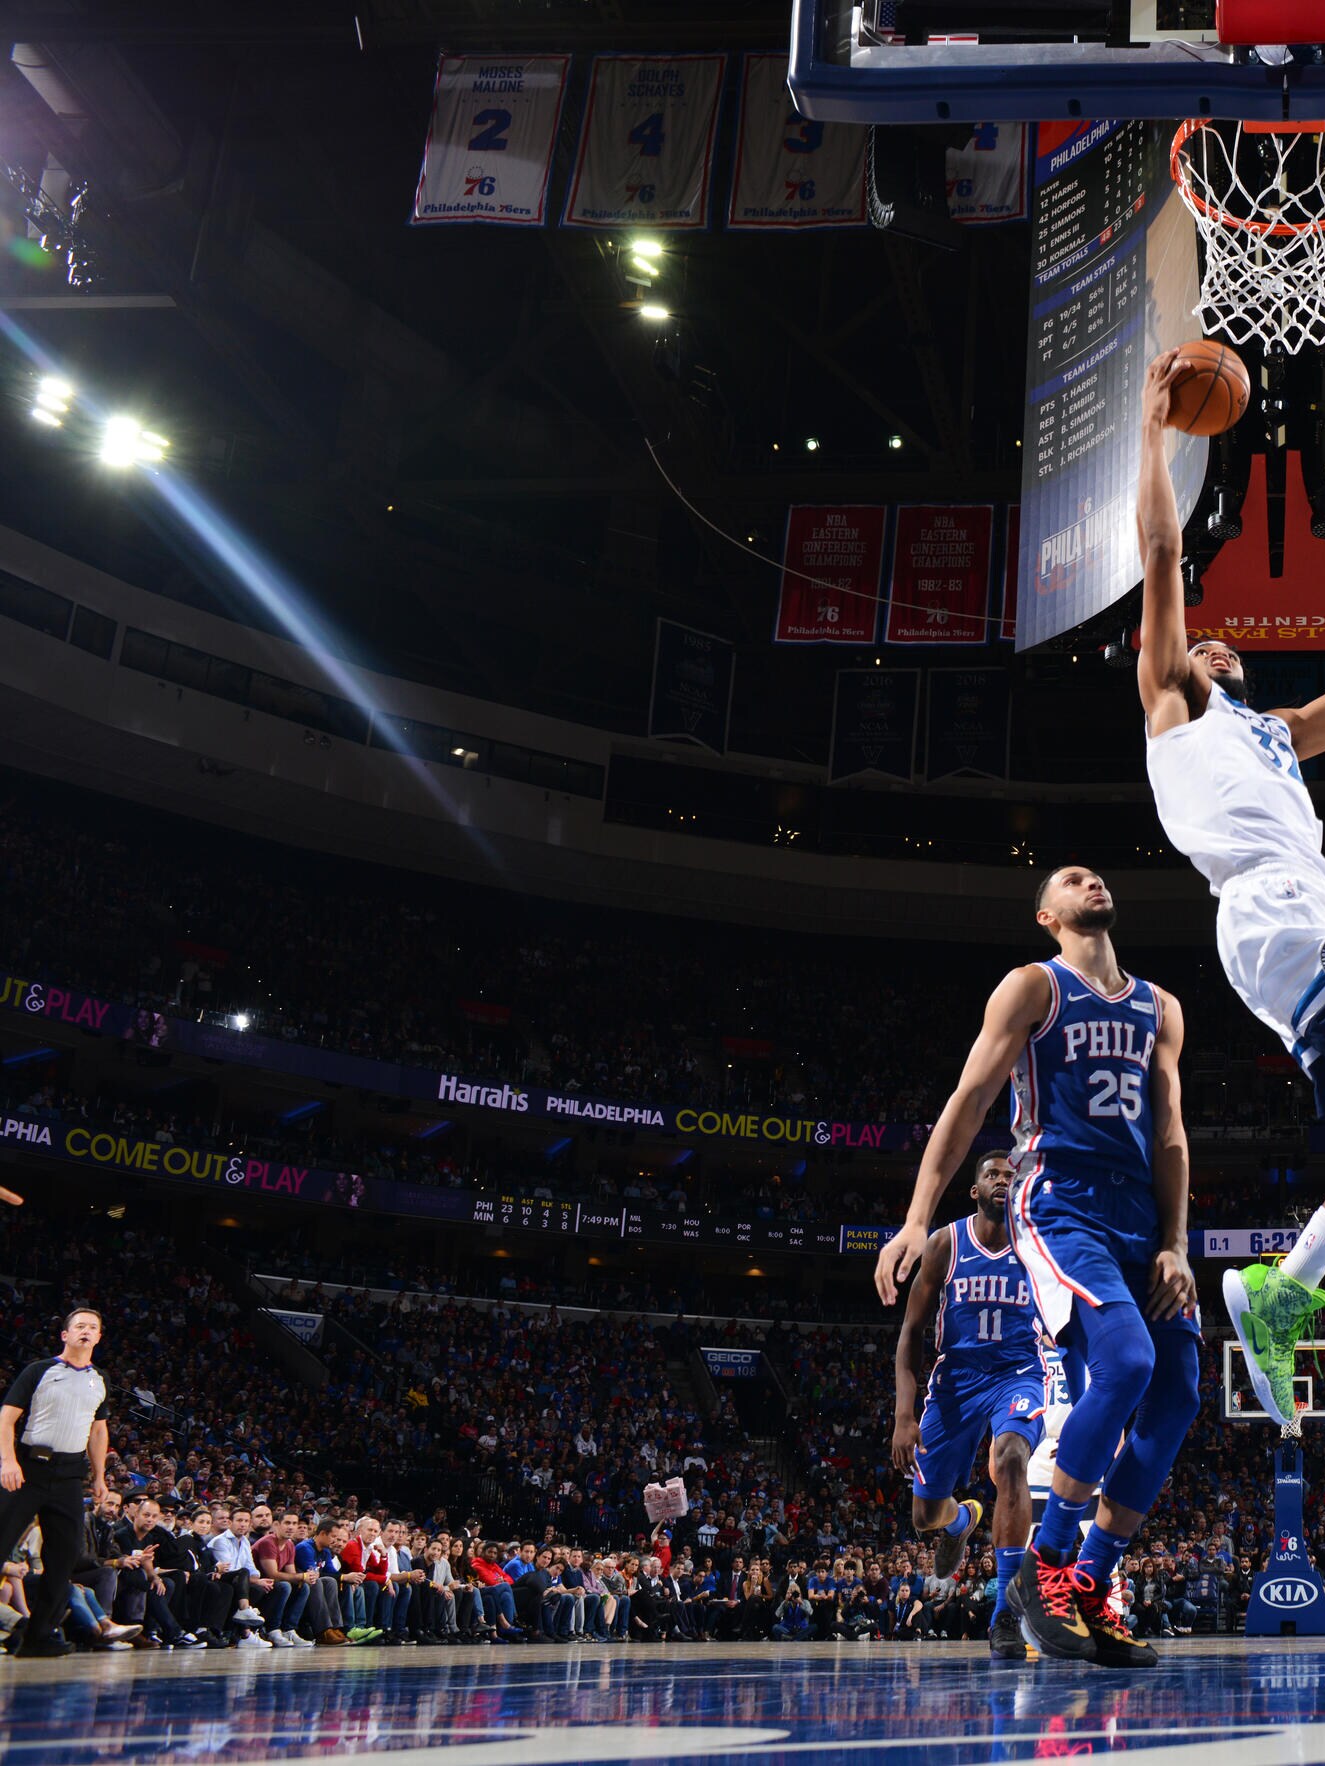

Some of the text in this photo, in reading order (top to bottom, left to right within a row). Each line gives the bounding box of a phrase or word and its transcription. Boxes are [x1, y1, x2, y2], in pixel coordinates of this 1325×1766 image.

[478, 66, 523, 79] MOSES
[637, 69, 680, 82] DOLPH
[472, 81, 524, 94] MALONE
[627, 84, 685, 97] SCHAYES
[467, 109, 512, 151] 2
[627, 113, 665, 157] 4
[784, 111, 824, 153] 3
[1050, 119, 1110, 172] PHILADELPHIA
[464, 176, 496, 196] 76
[625, 184, 656, 204] 76
[784, 179, 815, 200] 76
[1051, 179, 1079, 203] HARRIS
[423, 203, 531, 215] Philadelphia 76ers
[743, 206, 818, 218] Philadelphia
[1051, 189, 1086, 217] HORFORD
[582, 208, 655, 220] Philadelphia
[1050, 205, 1086, 233] SIMMONS
[1050, 229, 1072, 248] ENNIS
[1050, 234, 1086, 263] KORKMAZ
[1038, 248, 1089, 284] TEAM TOTALS
[1071, 256, 1116, 295] TEAM STATS
[1062, 338, 1118, 384] TEAM LEADERS
[1040, 374, 1098, 415] PTS HARRIS
[1039, 391, 1095, 431] REB EMBIID
[1038, 399, 1106, 446] AST SIMMONS
[1038, 423, 1095, 462] BLK EMBIID
[1038, 424, 1115, 478] STL RICHARDSON
[826, 514, 848, 527] NBA
[811, 528, 859, 540] EASTERN
[920, 529, 968, 541] EASTERN
[802, 541, 867, 553] CONFERENCE
[910, 543, 975, 555] CONFERENCE
[1041, 525, 1082, 576] PHILA
[804, 555, 863, 567] CHAMPIONS
[912, 556, 972, 568] CHAMPIONS
[918, 579, 962, 592] 1982-83
[816, 606, 840, 623] 76
[1224, 616, 1325, 627] CENTER
[1186, 627, 1269, 639] FARG
[1064, 1020, 1156, 1068] PHILA
[1088, 1069, 1142, 1121] 25
[546, 1096, 665, 1126] PHILADELPHIA
[676, 1109, 759, 1138] COME
[65, 1128, 160, 1171] COME
[473, 1210, 494, 1222] MIN
[475, 1200, 532, 1216] PHI 23 10
[582, 1214, 619, 1227] 7:49 PM
[847, 1231, 879, 1240] PLAYER
[1209, 1237, 1229, 1251] 0.1
[1250, 1232, 1297, 1254] 6:21
[847, 1241, 878, 1250] POINTS
[977, 1308, 1003, 1341] 11
[707, 1352, 753, 1364] GEICO
[1007, 1398, 1030, 1417] 76
[1280, 1537, 1298, 1551] 76
[1270, 1584, 1309, 1601] KIA
